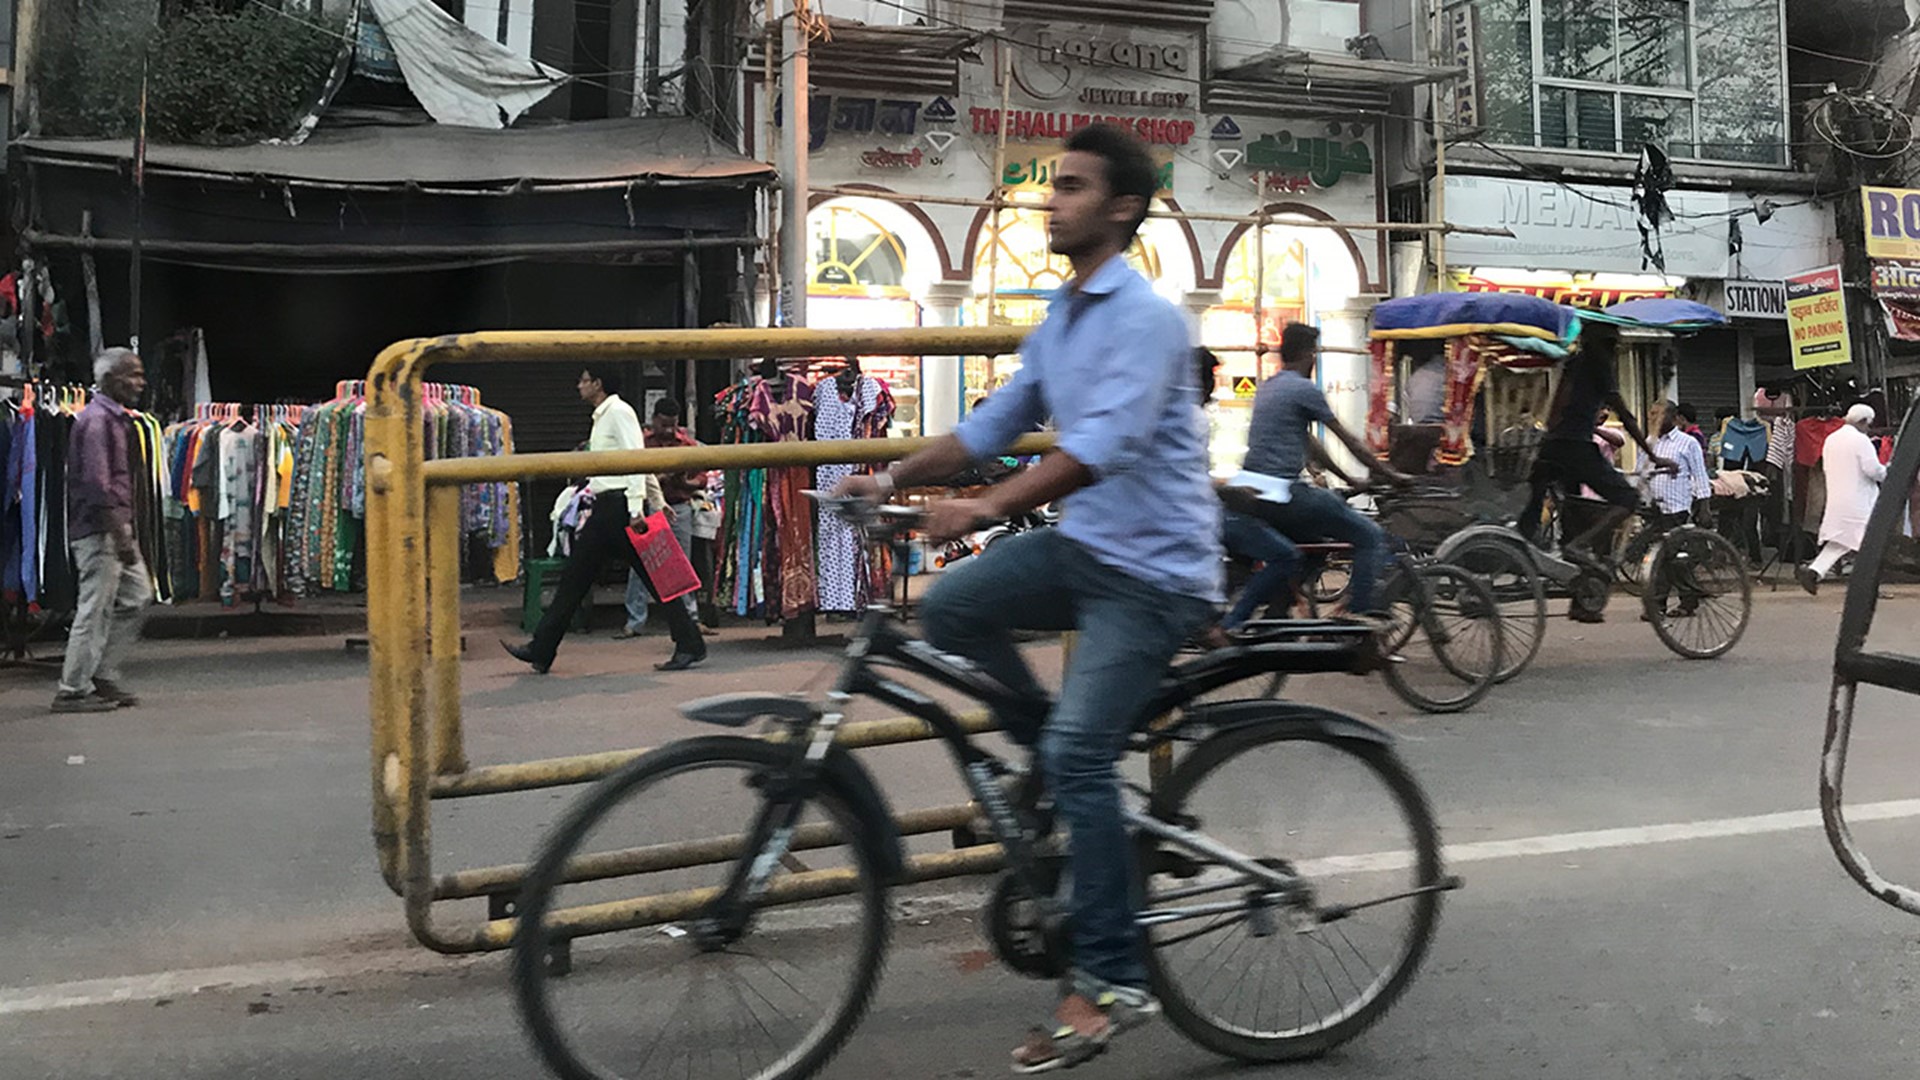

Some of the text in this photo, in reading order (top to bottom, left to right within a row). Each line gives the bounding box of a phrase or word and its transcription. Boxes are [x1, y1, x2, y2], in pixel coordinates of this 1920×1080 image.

[1079, 86, 1190, 108] JEWELLERY
[968, 106, 1014, 136] THE
[1136, 116, 1195, 145] SHOP
[1794, 320, 1844, 341] NO PARKING
